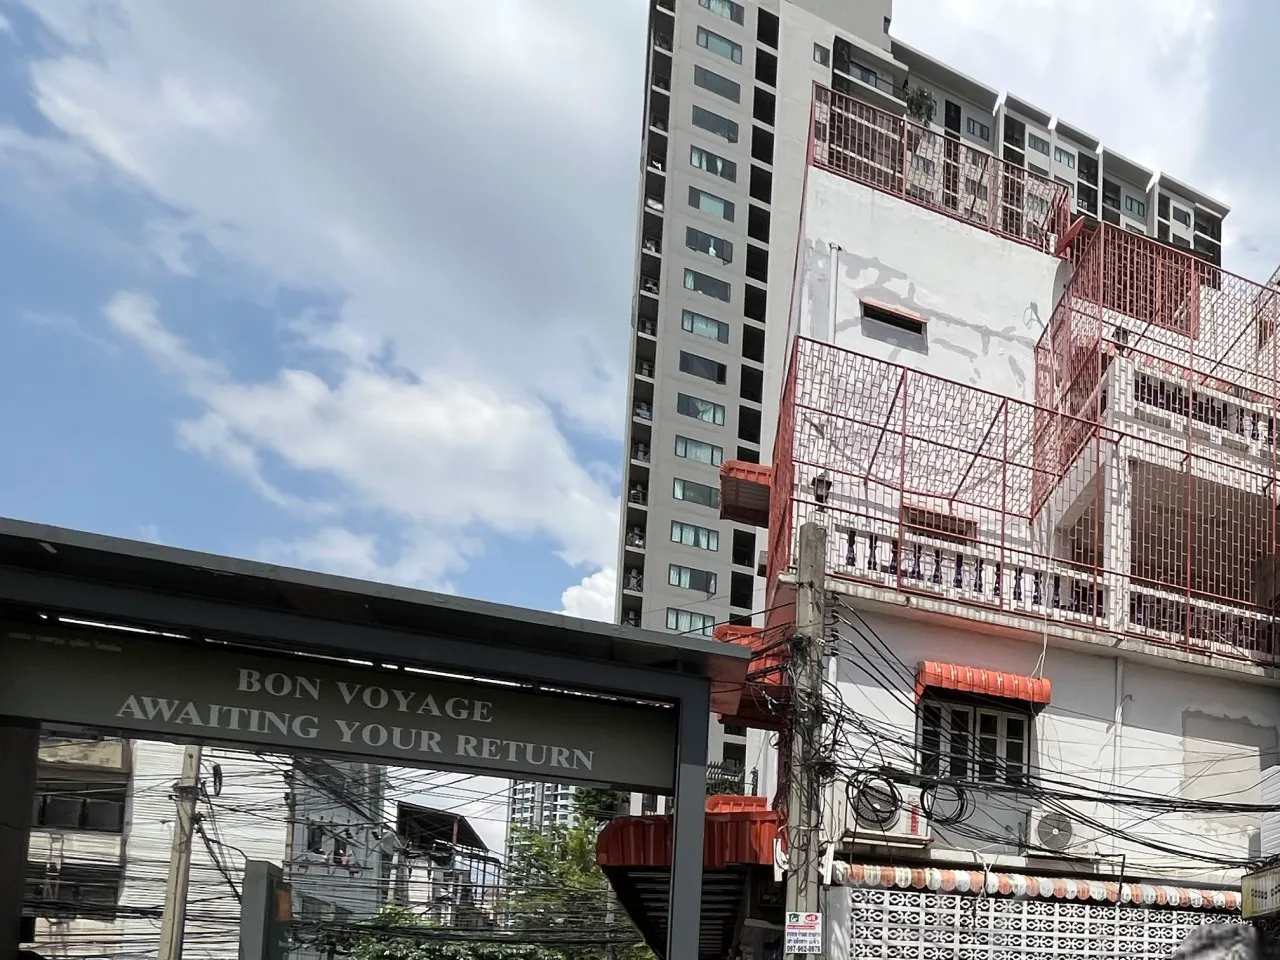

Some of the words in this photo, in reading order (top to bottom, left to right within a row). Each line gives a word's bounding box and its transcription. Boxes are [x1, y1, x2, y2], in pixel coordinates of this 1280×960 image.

[237, 668, 322, 700] BON
[336, 681, 494, 723] VOYAGE
[116, 694, 319, 739] AWAITING
[335, 719, 443, 753] YOUR
[455, 734, 595, 771] RETURN
